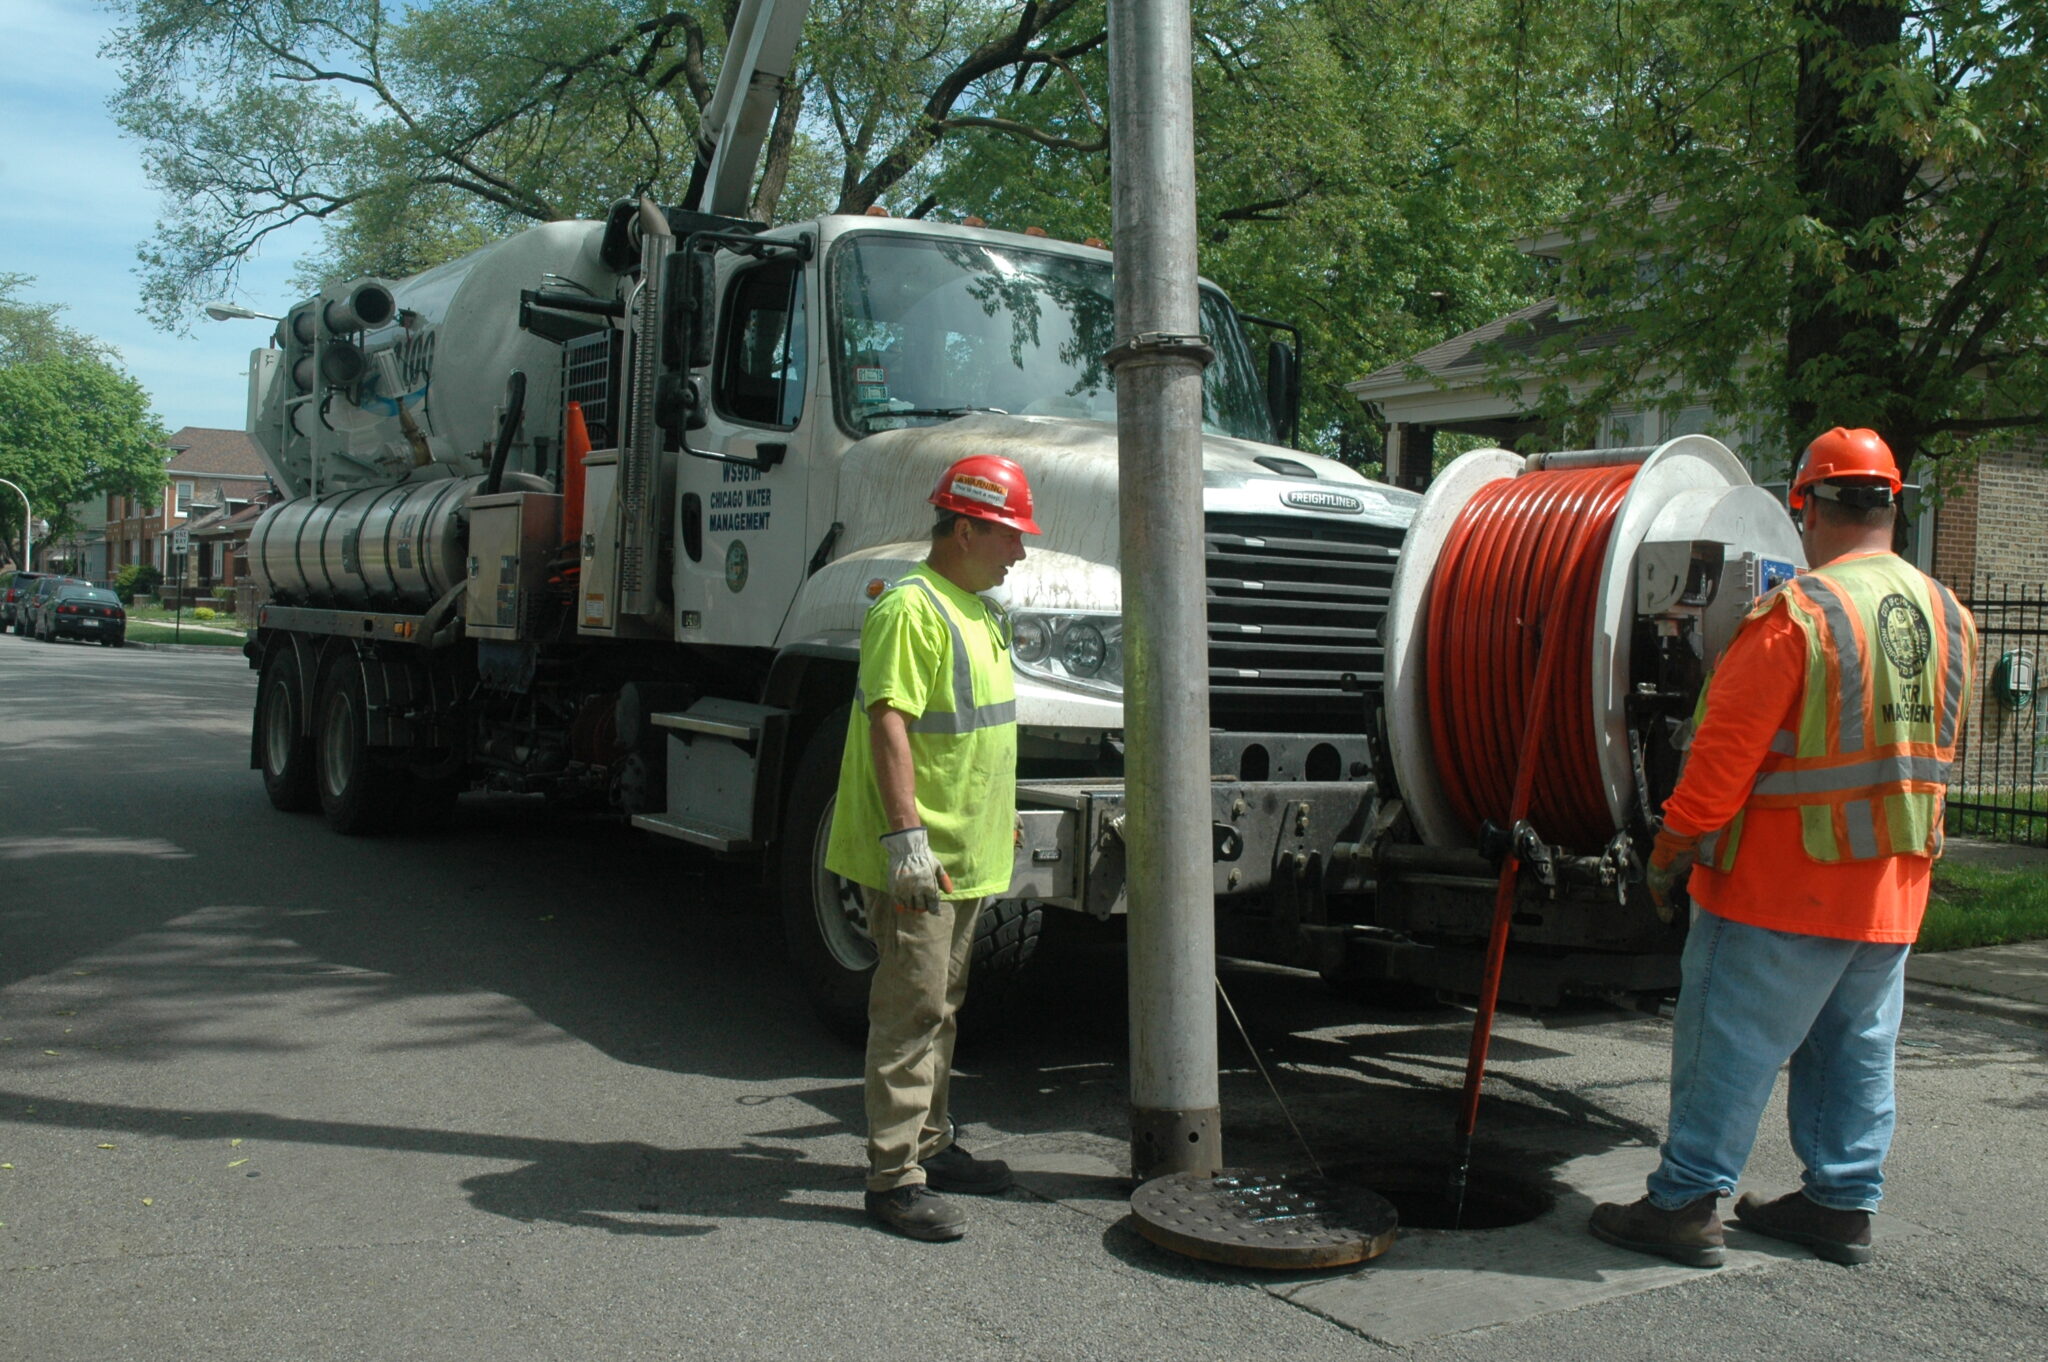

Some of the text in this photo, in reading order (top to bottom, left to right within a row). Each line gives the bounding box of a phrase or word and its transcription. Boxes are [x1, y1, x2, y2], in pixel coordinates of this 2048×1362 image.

[710, 488, 772, 510] CHICAGO WATER
[1291, 492, 1357, 508] FREIGHTLINER
[709, 512, 771, 532] MANAGEMENT
[175, 530, 188, 538] ONE
